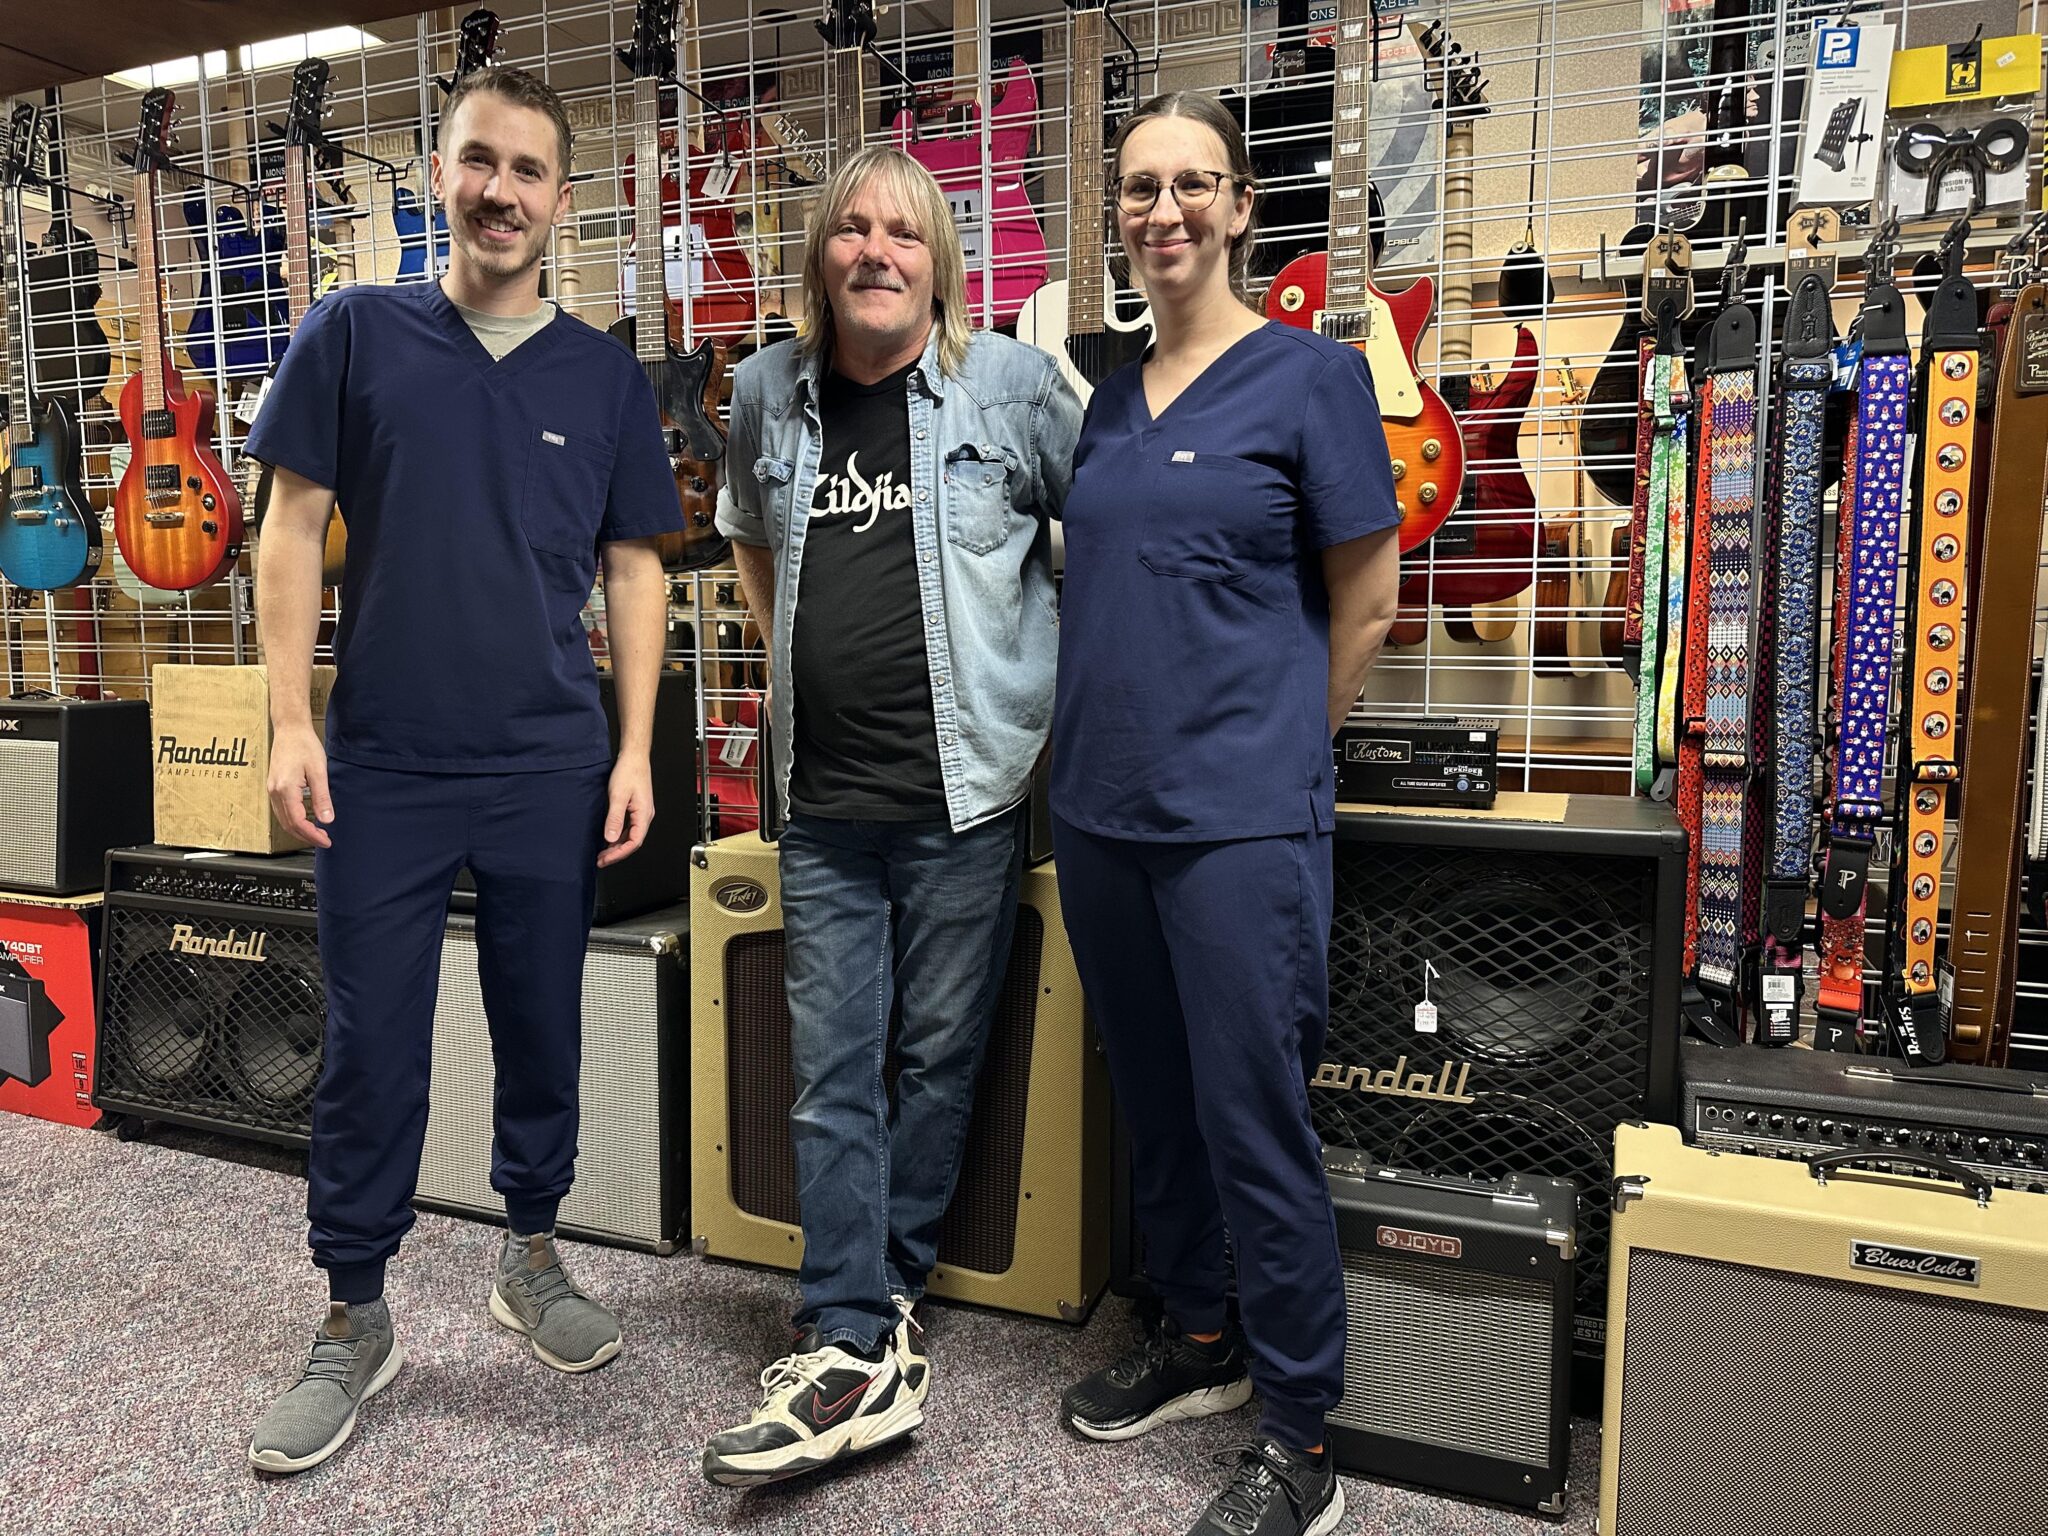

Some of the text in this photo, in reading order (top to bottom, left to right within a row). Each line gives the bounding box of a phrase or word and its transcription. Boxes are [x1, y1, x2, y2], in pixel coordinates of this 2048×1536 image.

[1940, 179, 1963, 187] ENSION
[1387, 237, 1420, 247] CABLE
[157, 736, 249, 766] Randall
[1353, 742, 1403, 760] Kustom
[167, 769, 240, 779] AMPLIFIERS
[168, 923, 268, 962] Randall
[1308, 1055, 1476, 1105] andall
[1864, 1247, 1968, 1277] BluesCube
